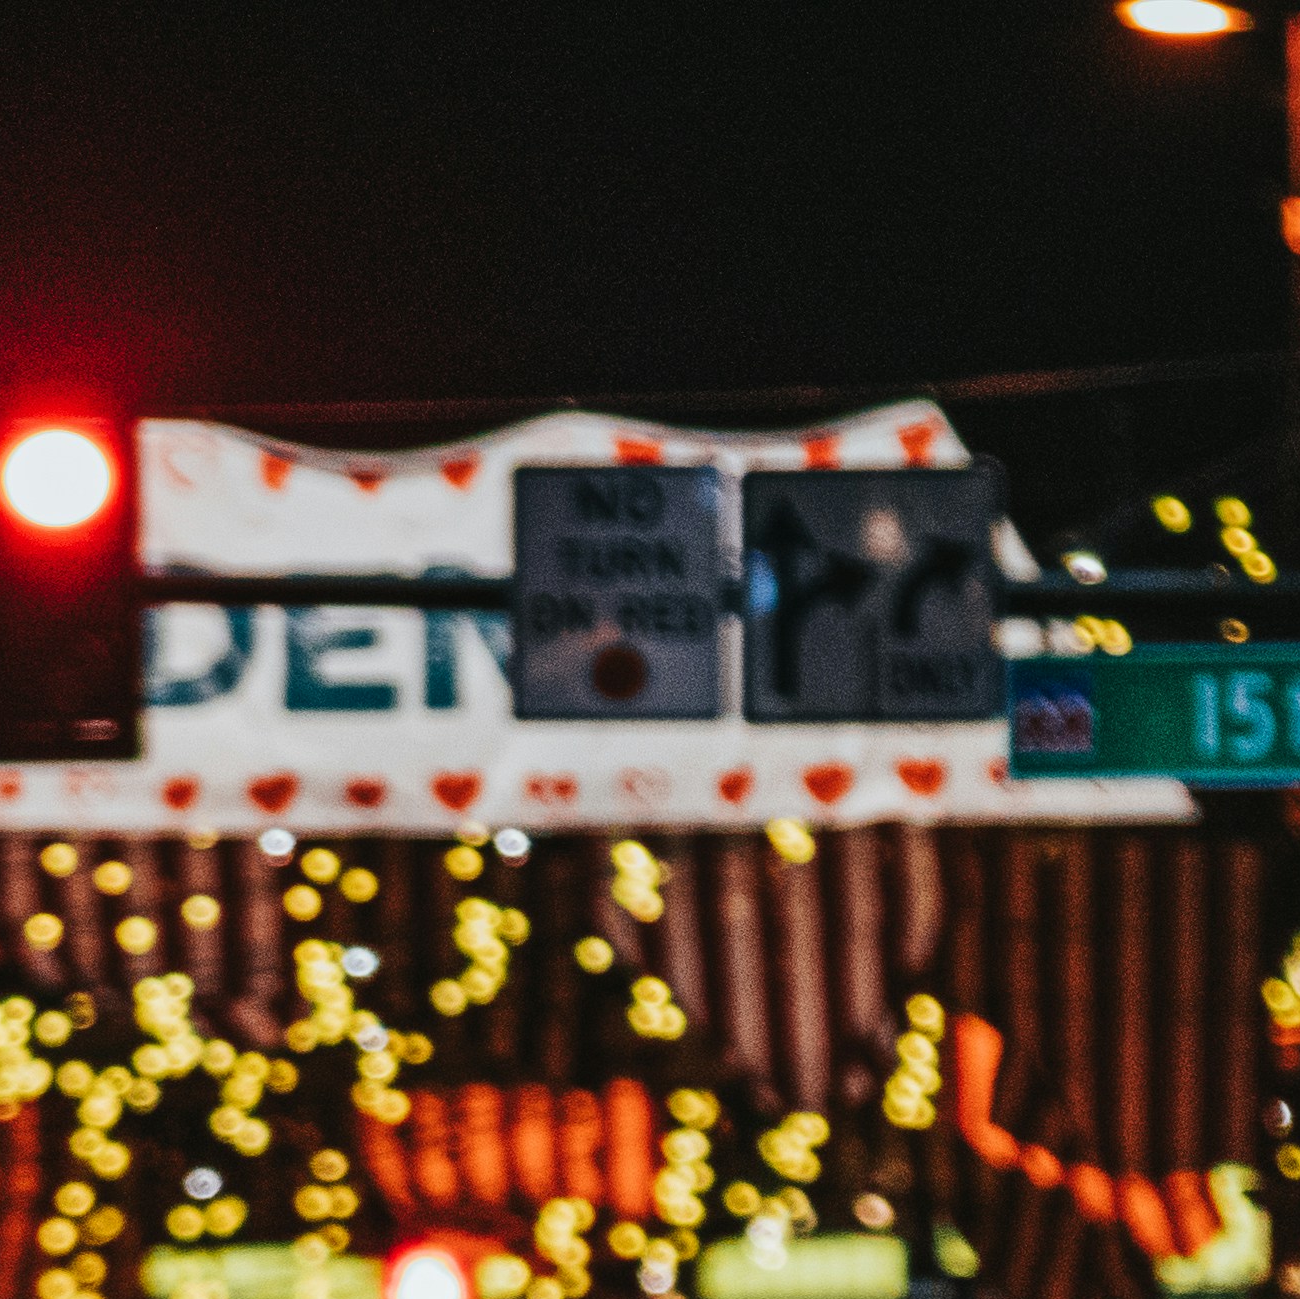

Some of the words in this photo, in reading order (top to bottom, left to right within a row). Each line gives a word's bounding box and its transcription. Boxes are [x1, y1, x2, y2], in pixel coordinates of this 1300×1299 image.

[571, 477, 665, 528] NO
[555, 537, 687, 583] TURN
[528, 593, 595, 639] ON
[617, 593, 712, 640] RED
